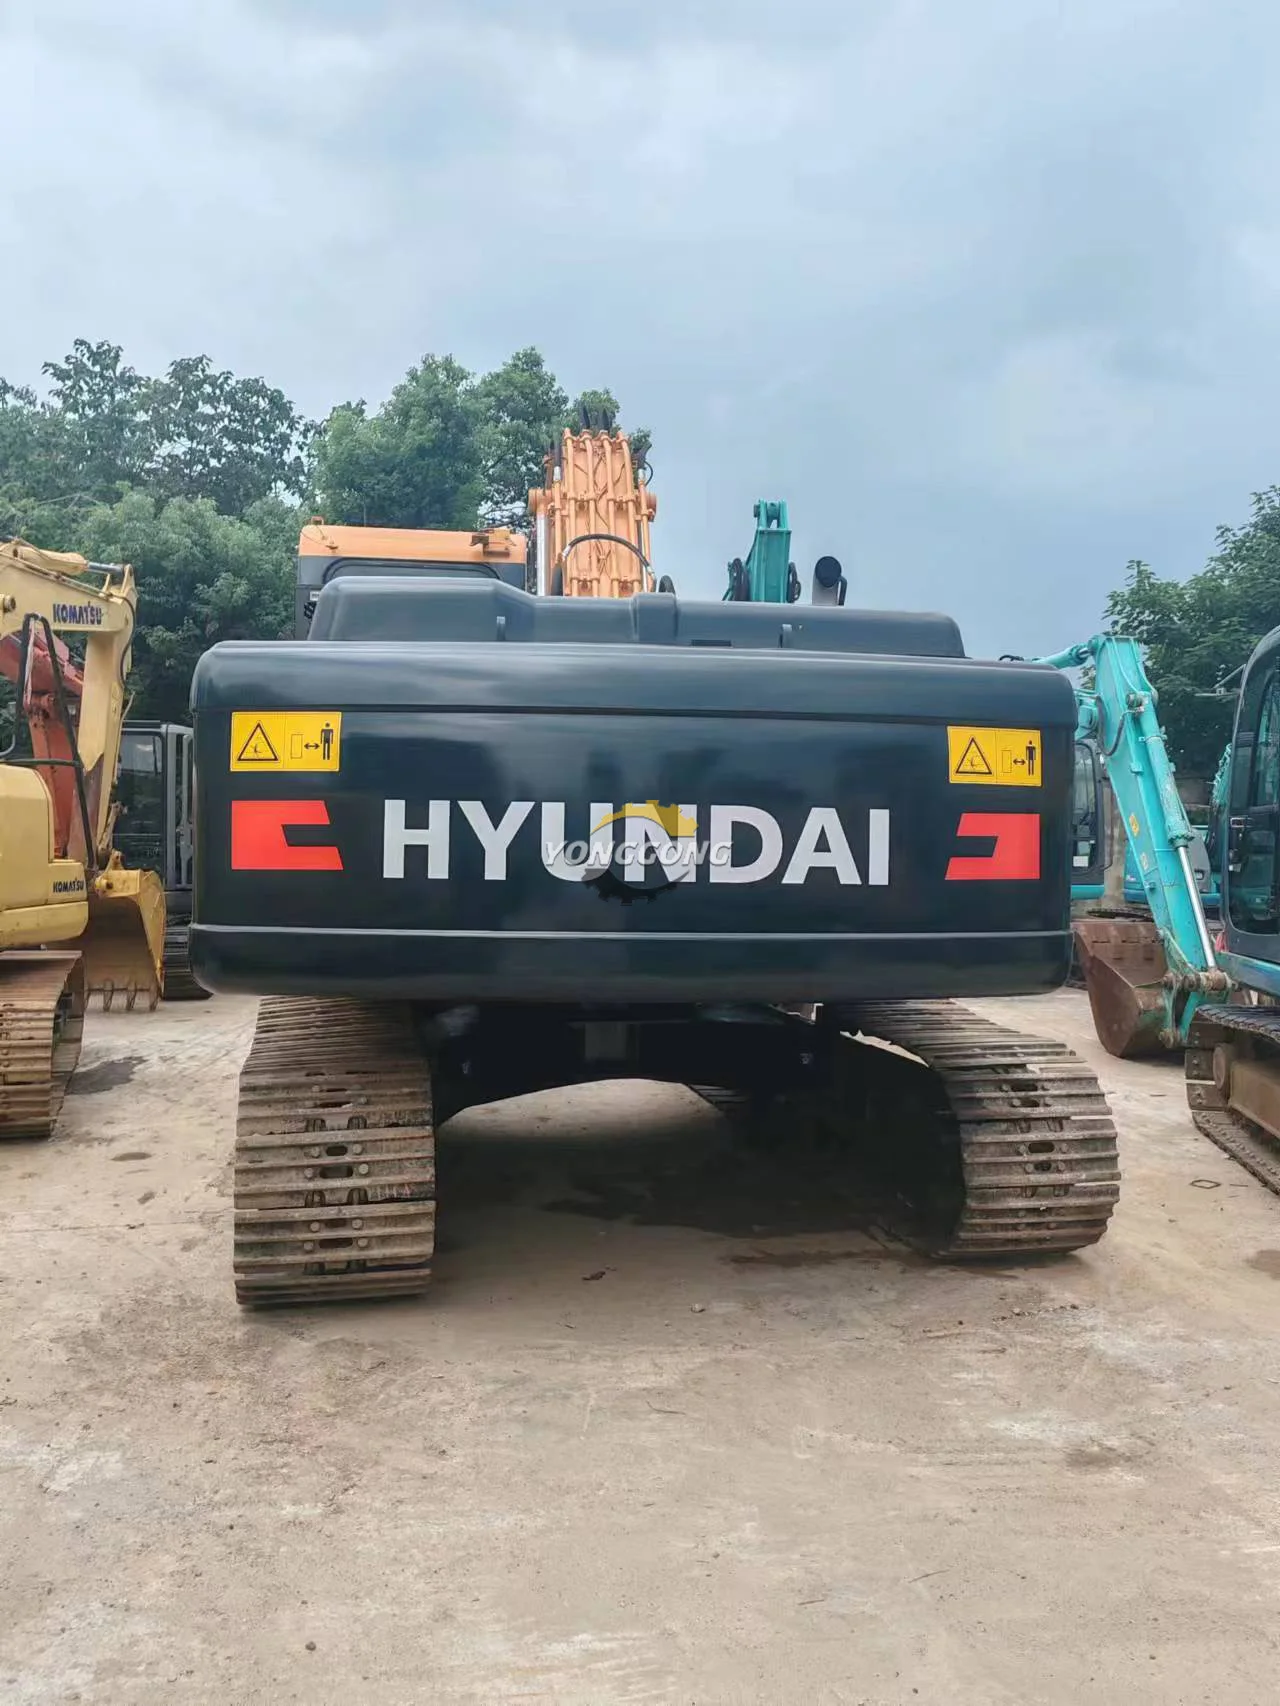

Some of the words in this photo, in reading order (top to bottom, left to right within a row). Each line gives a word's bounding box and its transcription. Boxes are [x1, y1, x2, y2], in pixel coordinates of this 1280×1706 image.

[53, 601, 102, 625] KOMATSU
[382, 799, 890, 886] HYUNDAI
[53, 878, 85, 893] KOMATSU
